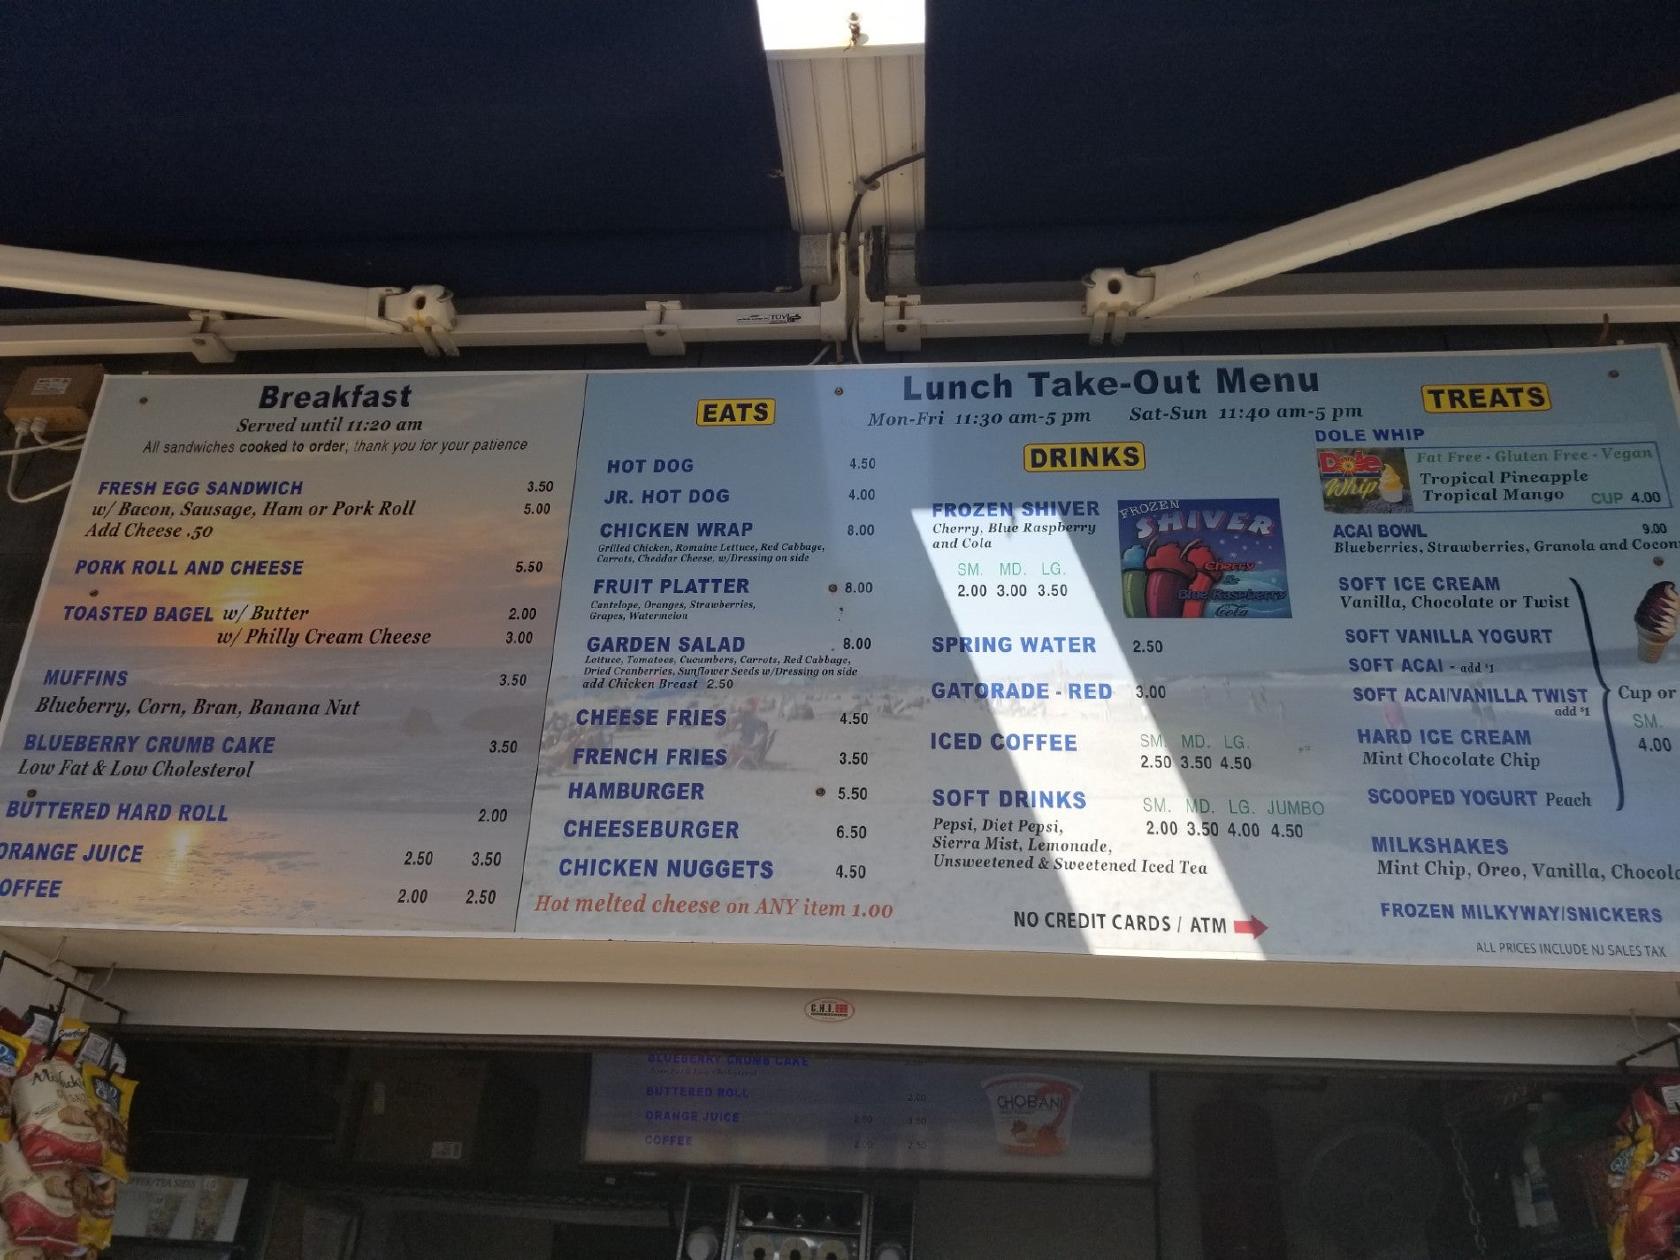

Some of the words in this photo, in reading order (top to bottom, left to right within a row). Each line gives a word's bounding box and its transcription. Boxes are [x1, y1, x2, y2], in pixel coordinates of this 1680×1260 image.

[904, 373, 1012, 400] Lunch
[1028, 369, 1200, 397] Take-Out
[1217, 368, 1319, 393] Menu
[259, 385, 412, 408] Breakfast
[1427, 387, 1545, 409] TREATS
[703, 403, 768, 422] EATS
[868, 411, 944, 426] Mon-Fri
[957, 413, 1002, 427] 11:30
[1009, 412, 1056, 425] am-5
[1061, 412, 1091, 426] pm
[1130, 406, 1207, 421] Sat-Sun
[1219, 408, 1270, 422] 11:40
[1277, 408, 1325, 420] am-5
[1332, 408, 1362, 421] pm
[236, 417, 297, 432] Served
[301, 417, 343, 431] until
[347, 420, 391, 431] 11:20
[396, 421, 422, 431] am
[1315, 430, 1366, 442] DOLE
[1372, 429, 1424, 440] WHIP
[143, 441, 160, 453] All
[163, 441, 235, 453] sandwiches
[240, 440, 287, 452] cooked
[293, 441, 304, 452] to
[354, 440, 389, 452] thank
[392, 442, 416, 455] you
[420, 439, 438, 451] for
[440, 441, 470, 454] your
[472, 440, 528, 454] patience
[608, 460, 646, 473] HOT
[654, 459, 693, 472] DOG
[850, 458, 875, 469] 4.50
[1031, 447, 1139, 467] DRINKS
[1318, 451, 1384, 474] Dole
[98, 482, 157, 495] FRESH
[162, 482, 199, 495] EGG
[206, 481, 303, 495] SANDWICH
[528, 481, 553, 492] 3.50
[1324, 476, 1378, 499] Whip
[1423, 488, 1497, 503] Tropical
[1504, 489, 1563, 502] Mango
[1592, 492, 1623, 504] CUP
[1632, 492, 1661, 503] 4.00
[932, 501, 1013, 518] FROZEN
[1022, 500, 1099, 517] SHIVER
[1120, 499, 1180, 519] FROZEN
[85, 522, 121, 537] Add
[125, 522, 182, 537] Cheese
[187, 526, 213, 540] .50
[600, 523, 689, 538] CHICKEN
[697, 523, 752, 536] WRAP
[848, 524, 874, 536] 8.00
[933, 523, 982, 536] Cherry,
[989, 523, 1018, 533] Blue
[1023, 522, 1095, 535] Raspberry
[1136, 510, 1276, 539] SHIVER
[1333, 525, 1372, 538] ACAI
[1378, 524, 1427, 537] BOWL
[1643, 523, 1667, 534] 9.00
[75, 560, 126, 575] PORK
[132, 560, 178, 574] ROLL
[184, 561, 224, 575] AND
[231, 561, 304, 575] CHEESE
[516, 561, 543, 572] 5.50
[957, 562, 983, 576] SM.
[999, 562, 1026, 576] MD.
[1041, 562, 1066, 576] LG.
[594, 579, 653, 594] FRUIT
[660, 579, 749, 593] PLATTER
[845, 582, 872, 593] 8.00
[958, 585, 987, 597] 2.00
[997, 585, 1027, 597] 3.00
[1038, 584, 1067, 596] 3.50
[1339, 577, 1386, 591] SOFT
[1394, 577, 1425, 591] ICE
[1433, 577, 1500, 591] CREAM
[932, 637, 1012, 652] SPRING
[1020, 637, 1096, 652] WATER
[1133, 640, 1163, 652] 2.50
[43, 670, 128, 686] MUFFINS
[500, 674, 526, 686] 3.50
[583, 678, 605, 688] add
[608, 678, 654, 688] Chicken
[659, 679, 698, 688] Breast
[707, 679, 733, 689] 2.50
[35, 696, 130, 718] Blueberry,
[138, 698, 186, 715] Corn,
[192, 699, 241, 716] Bran,
[248, 699, 320, 715] Banana
[325, 699, 360, 715] Nut
[577, 709, 658, 726] CHEESE
[667, 710, 726, 726] FRIES
[840, 713, 868, 724] 4.50
[932, 789, 989, 806] SOFT
[1000, 791, 1086, 809] DRINKS
[1368, 788, 1455, 805] SCOOPED
[1460, 790, 1537, 806] YOGURT
[1546, 792, 1592, 806] Peach
[1143, 798, 1170, 812] SM.
[1186, 799, 1215, 813] MD.
[1230, 800, 1255, 814] LG.
[1267, 800, 1325, 816] JUMBO
[933, 818, 976, 834] Pepsi,
[983, 819, 1013, 831] Diet
[1019, 820, 1063, 836] Pepsi,
[1147, 821, 1177, 835] 2.00
[1187, 822, 1218, 836] 3.50
[1228, 823, 1259, 837] 4.00
[1272, 824, 1302, 837] 4.50
[1372, 836, 1508, 855] MILKSHAKES
[83, 844, 143, 862] JUICE
[404, 851, 433, 865] 2.50
[472, 852, 501, 866] 3.50
[559, 859, 658, 877] CHICKEN
[667, 860, 773, 879] NUGGETS
[836, 865, 866, 879] 4.50
[534, 895, 569, 911] Hot
[576, 893, 646, 912] melted
[652, 894, 720, 913] cheese
[727, 903, 749, 913] on
[755, 898, 799, 914] ANY
[804, 898, 845, 916] item
[852, 904, 893, 918] 1.00
[1381, 903, 1454, 919] FROZEN
[1461, 905, 1662, 923] MILKYWAY/SNICKERS
[1014, 911, 1038, 927] NO
[1045, 912, 1106, 928] CREDIT
[1112, 914, 1170, 931] CARDS
[1177, 916, 1181, 933] /
[1191, 917, 1226, 933] ATM
[1477, 942, 1496, 952] ALL
[1499, 943, 1536, 953] PRICES
[1540, 944, 1589, 955] INCLUDE
[1592, 945, 1604, 955] NJ
[1608, 945, 1642, 956] SALES
[1644, 945, 1667, 957] TAX
